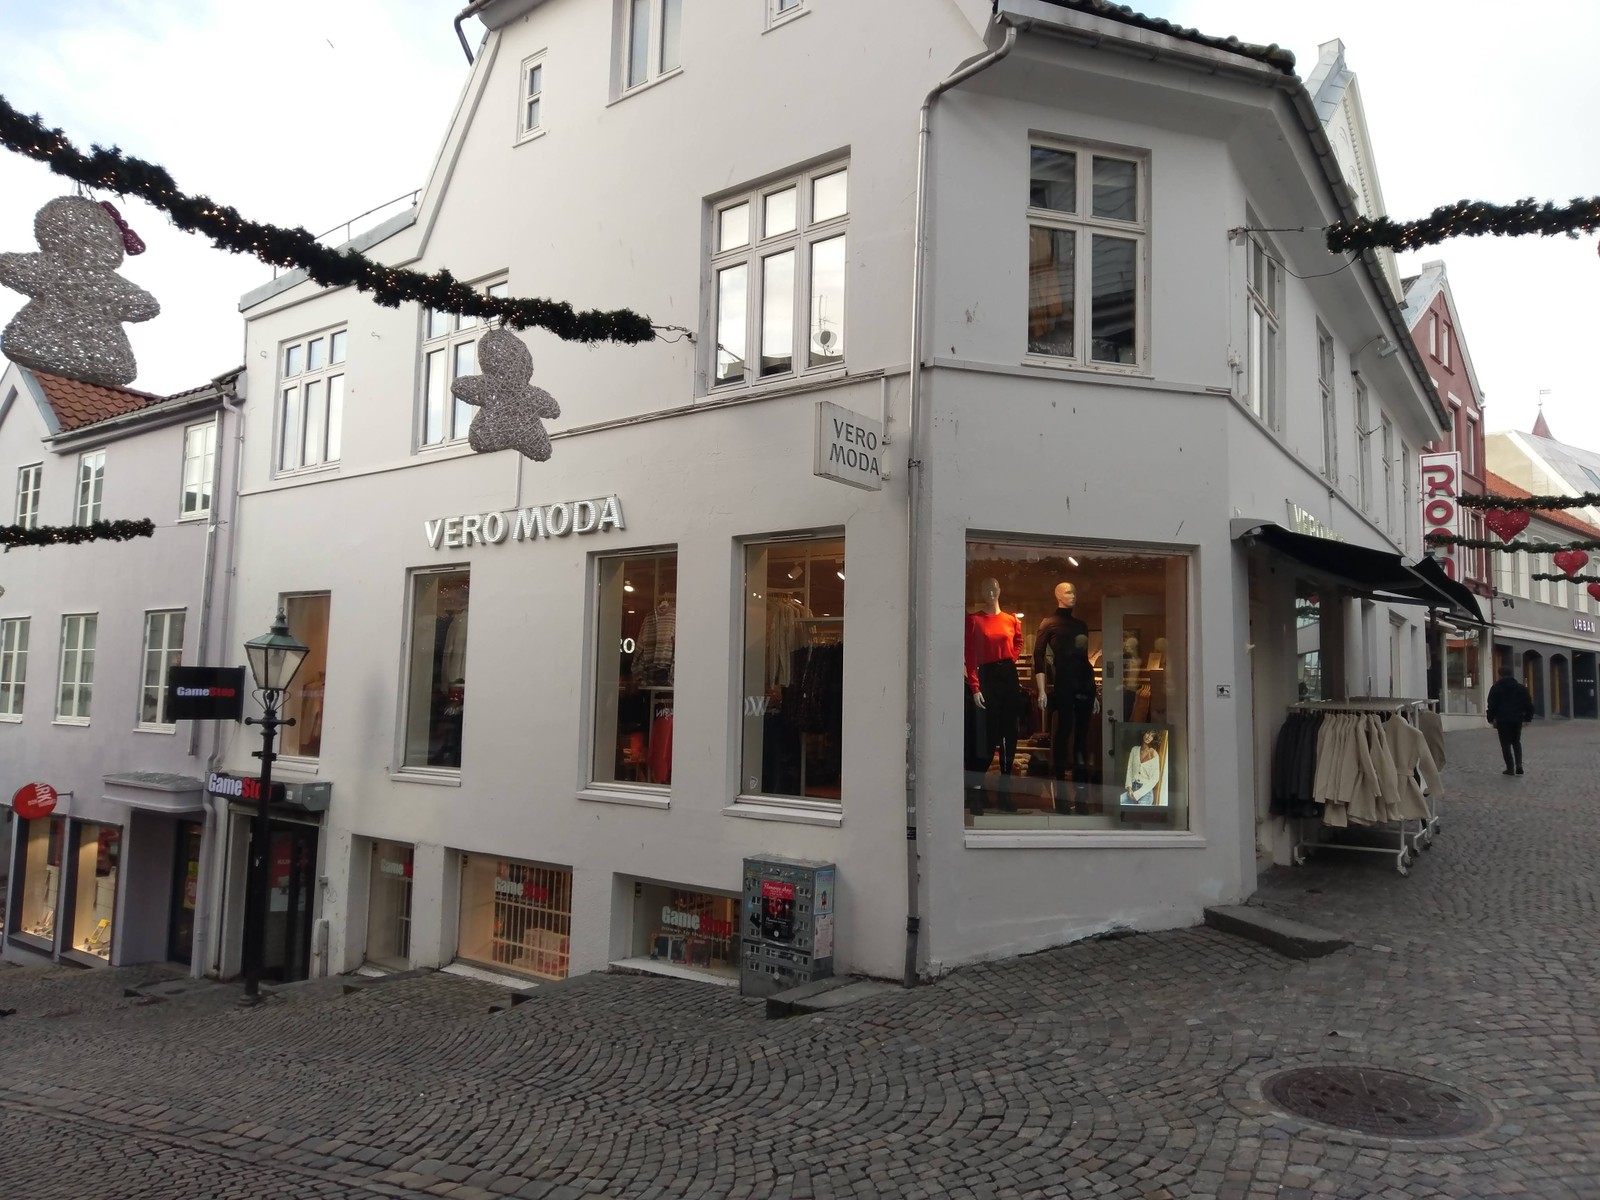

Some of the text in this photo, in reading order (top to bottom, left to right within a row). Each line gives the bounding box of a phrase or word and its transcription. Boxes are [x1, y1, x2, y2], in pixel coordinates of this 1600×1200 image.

[833, 418, 877, 450] VERO
[829, 443, 879, 476] MODA
[424, 496, 624, 549] VERO MODA
[1573, 616, 1596, 633] URBAN
[176, 686, 236, 697] GameStop
